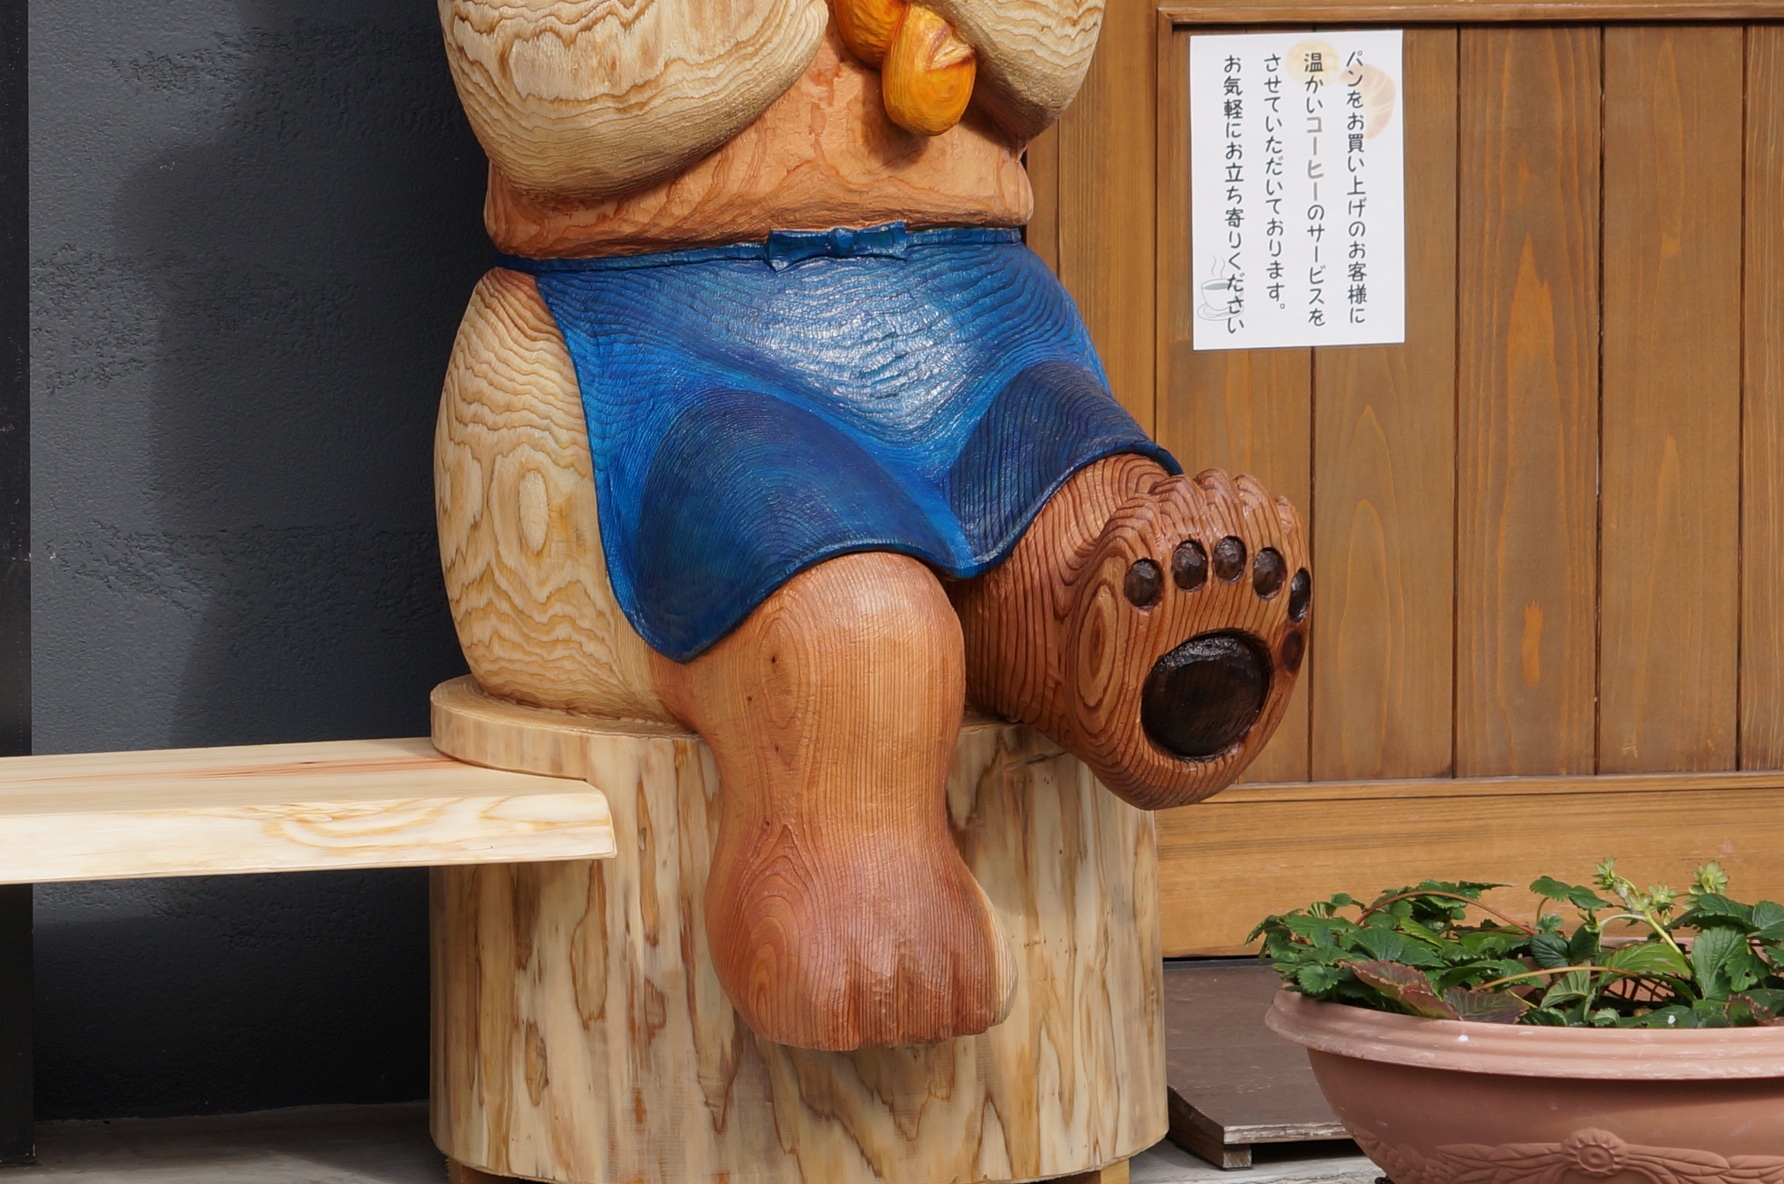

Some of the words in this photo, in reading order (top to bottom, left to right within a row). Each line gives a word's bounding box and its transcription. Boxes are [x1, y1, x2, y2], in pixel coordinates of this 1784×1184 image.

[1222, 54, 1245, 335] お気軽にお立ち寄りください
[1263, 52, 1286, 311] させていただいております。
[1303, 52, 1326, 328] 温かいコーヒーのサービスを
[1346, 50, 1368, 325] パンをお買い上げのお客様に
